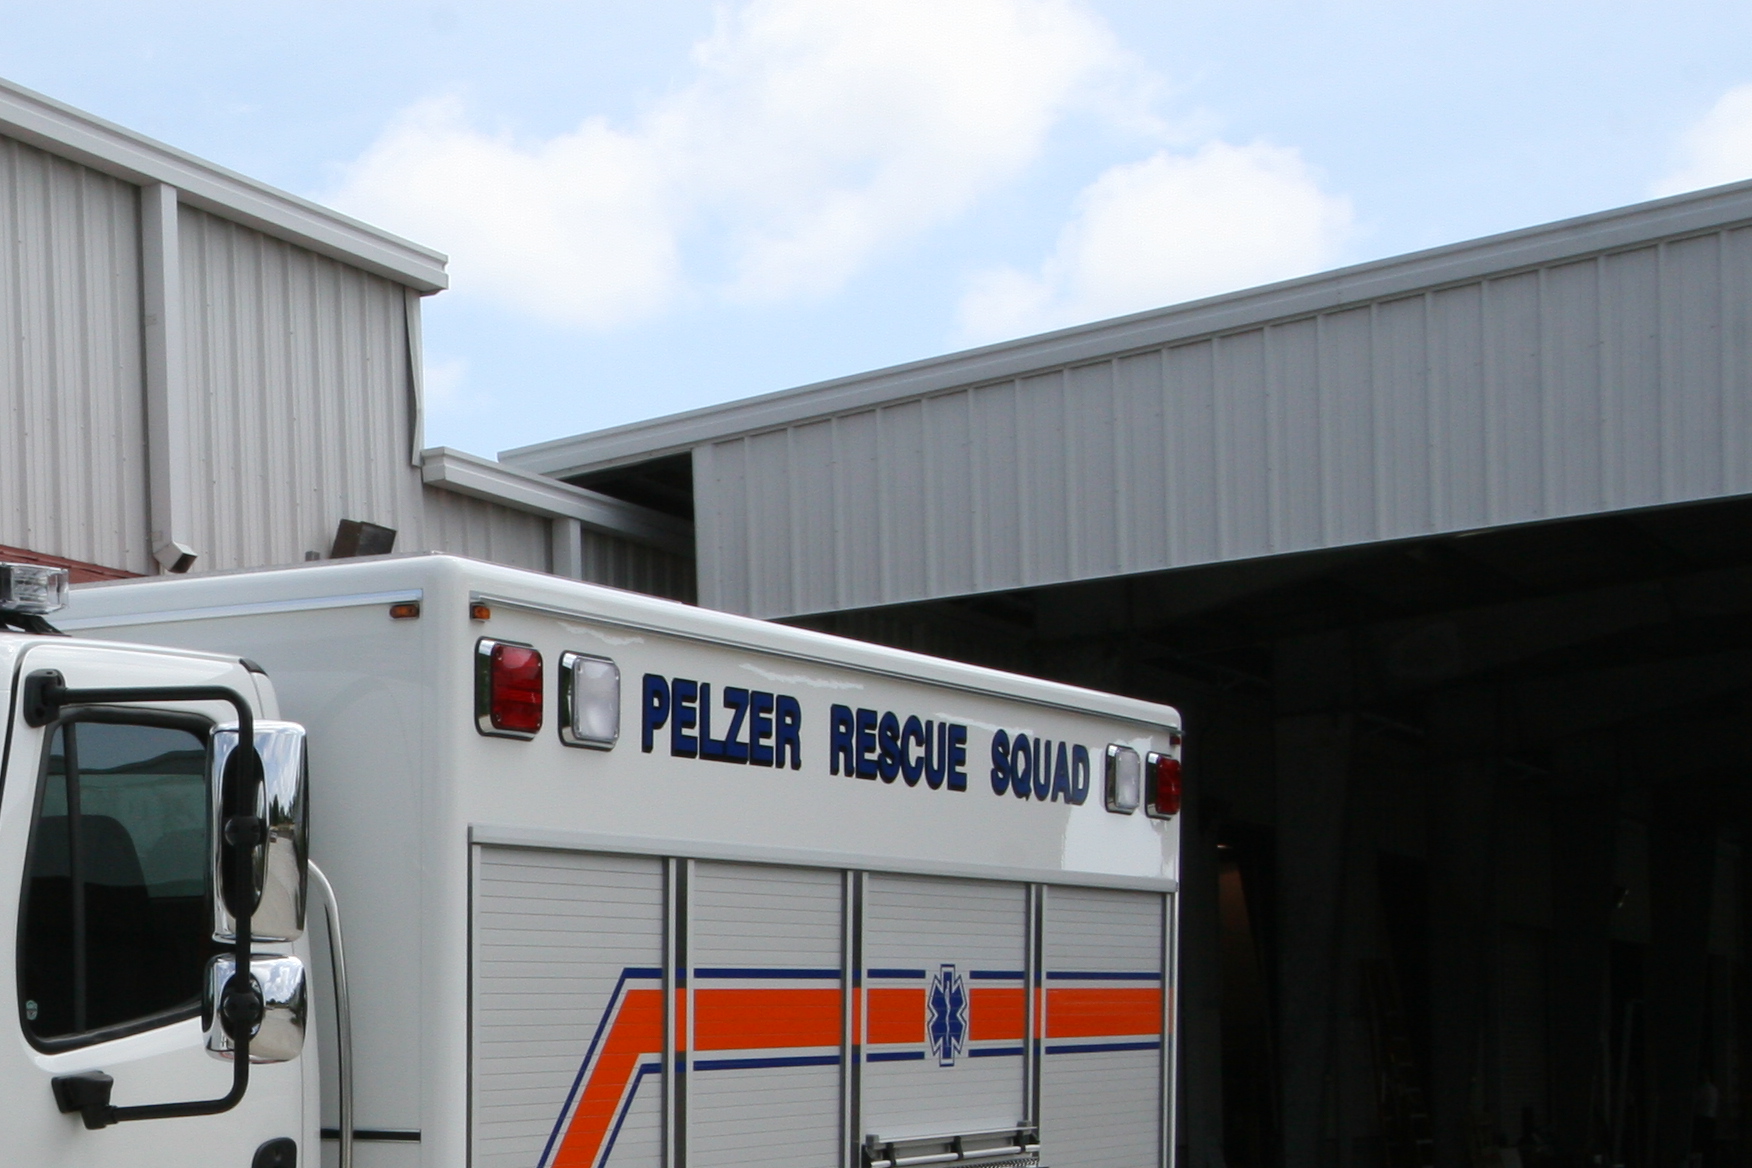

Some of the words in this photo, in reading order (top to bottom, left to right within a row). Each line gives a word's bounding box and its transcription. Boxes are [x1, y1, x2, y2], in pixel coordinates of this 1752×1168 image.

[642, 672, 802, 770] PELZER
[830, 703, 968, 792] RESCUE
[991, 729, 1090, 805] SQUAD
